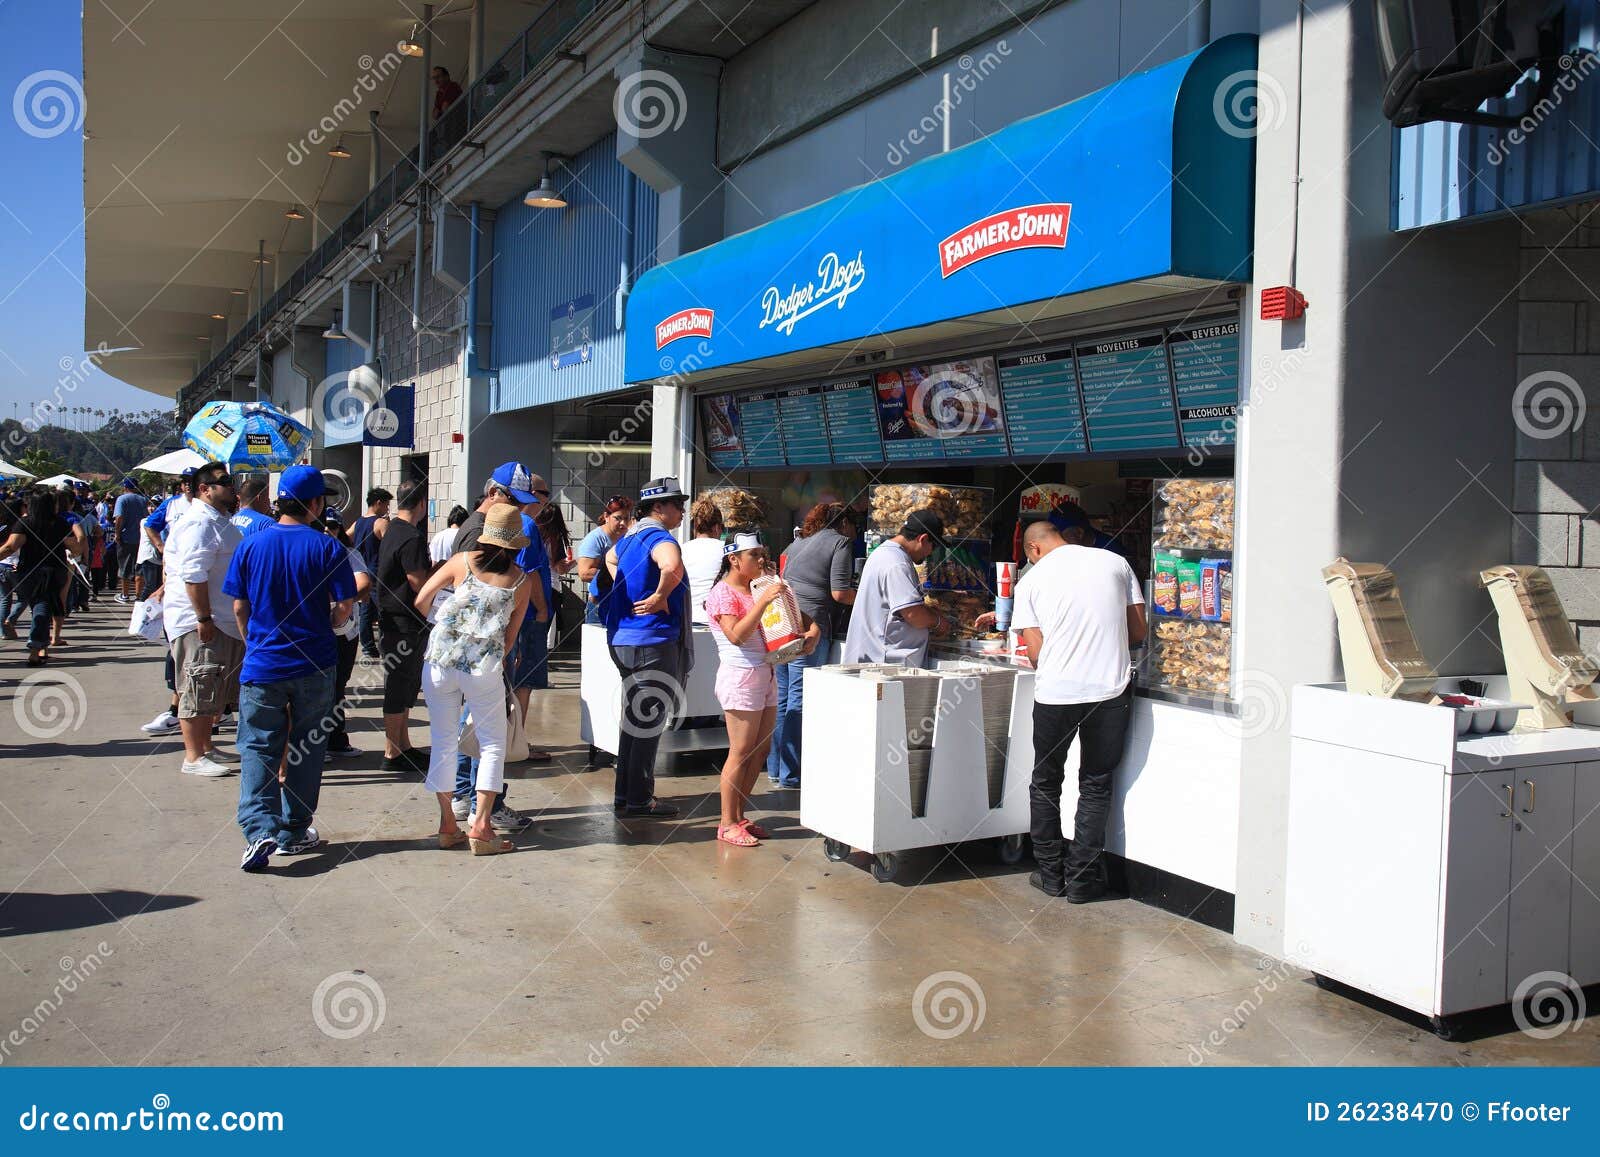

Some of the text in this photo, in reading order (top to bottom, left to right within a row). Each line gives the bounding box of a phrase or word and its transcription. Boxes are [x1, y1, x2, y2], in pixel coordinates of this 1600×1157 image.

[944, 212, 1063, 268] FARMER JOHN
[759, 250, 865, 336] Dodger Dogs
[658, 312, 711, 343] FARMER JOHN
[1096, 339, 1139, 354] NOVELTIES
[1020, 353, 1047, 365] SNACKS
[1188, 406, 1230, 419] ALCOHOLIC
[1021, 492, 1041, 511] POP
